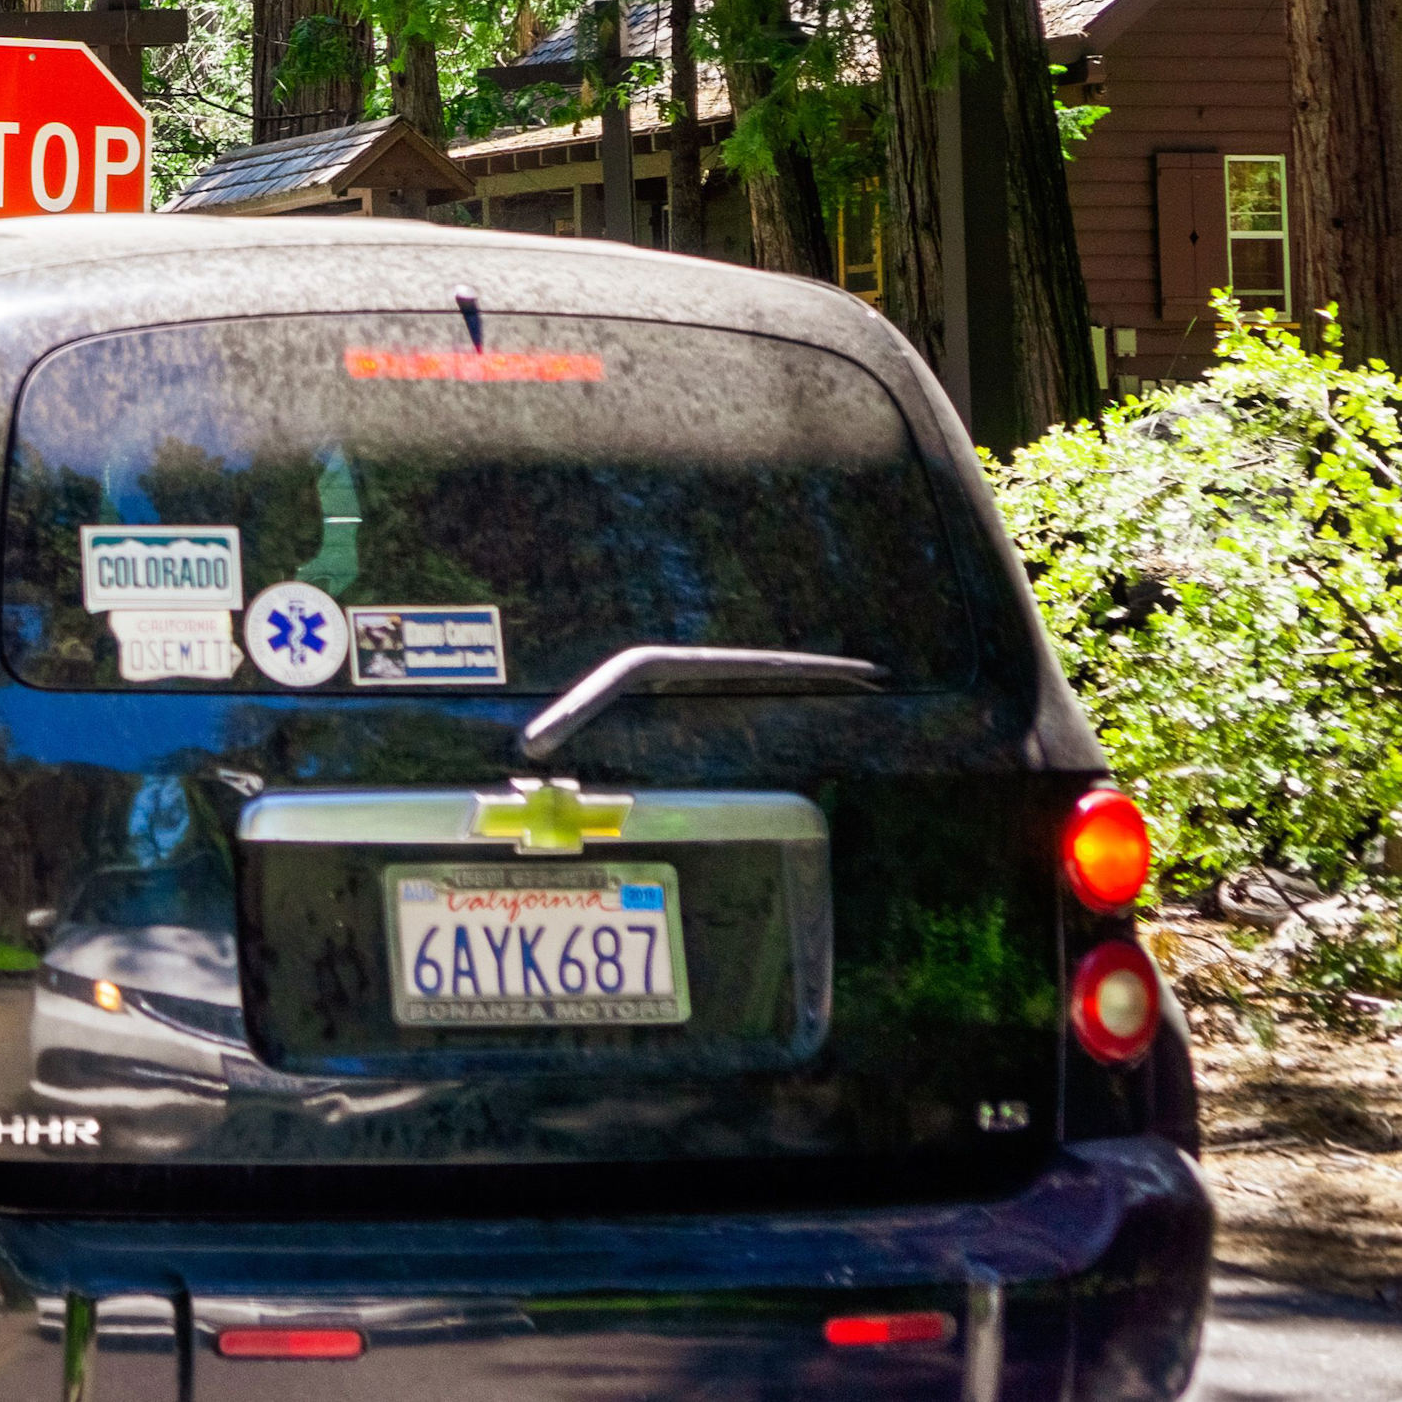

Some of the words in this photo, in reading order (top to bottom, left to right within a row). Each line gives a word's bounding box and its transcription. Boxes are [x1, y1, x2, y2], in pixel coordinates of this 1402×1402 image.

[97, 555, 230, 590] COLORADO
[447, 889, 621, 922] California
[413, 925, 658, 998] 6AYK687
[410, 1001, 546, 1020] BONANZA
[554, 1001, 674, 1019] MOTORS
